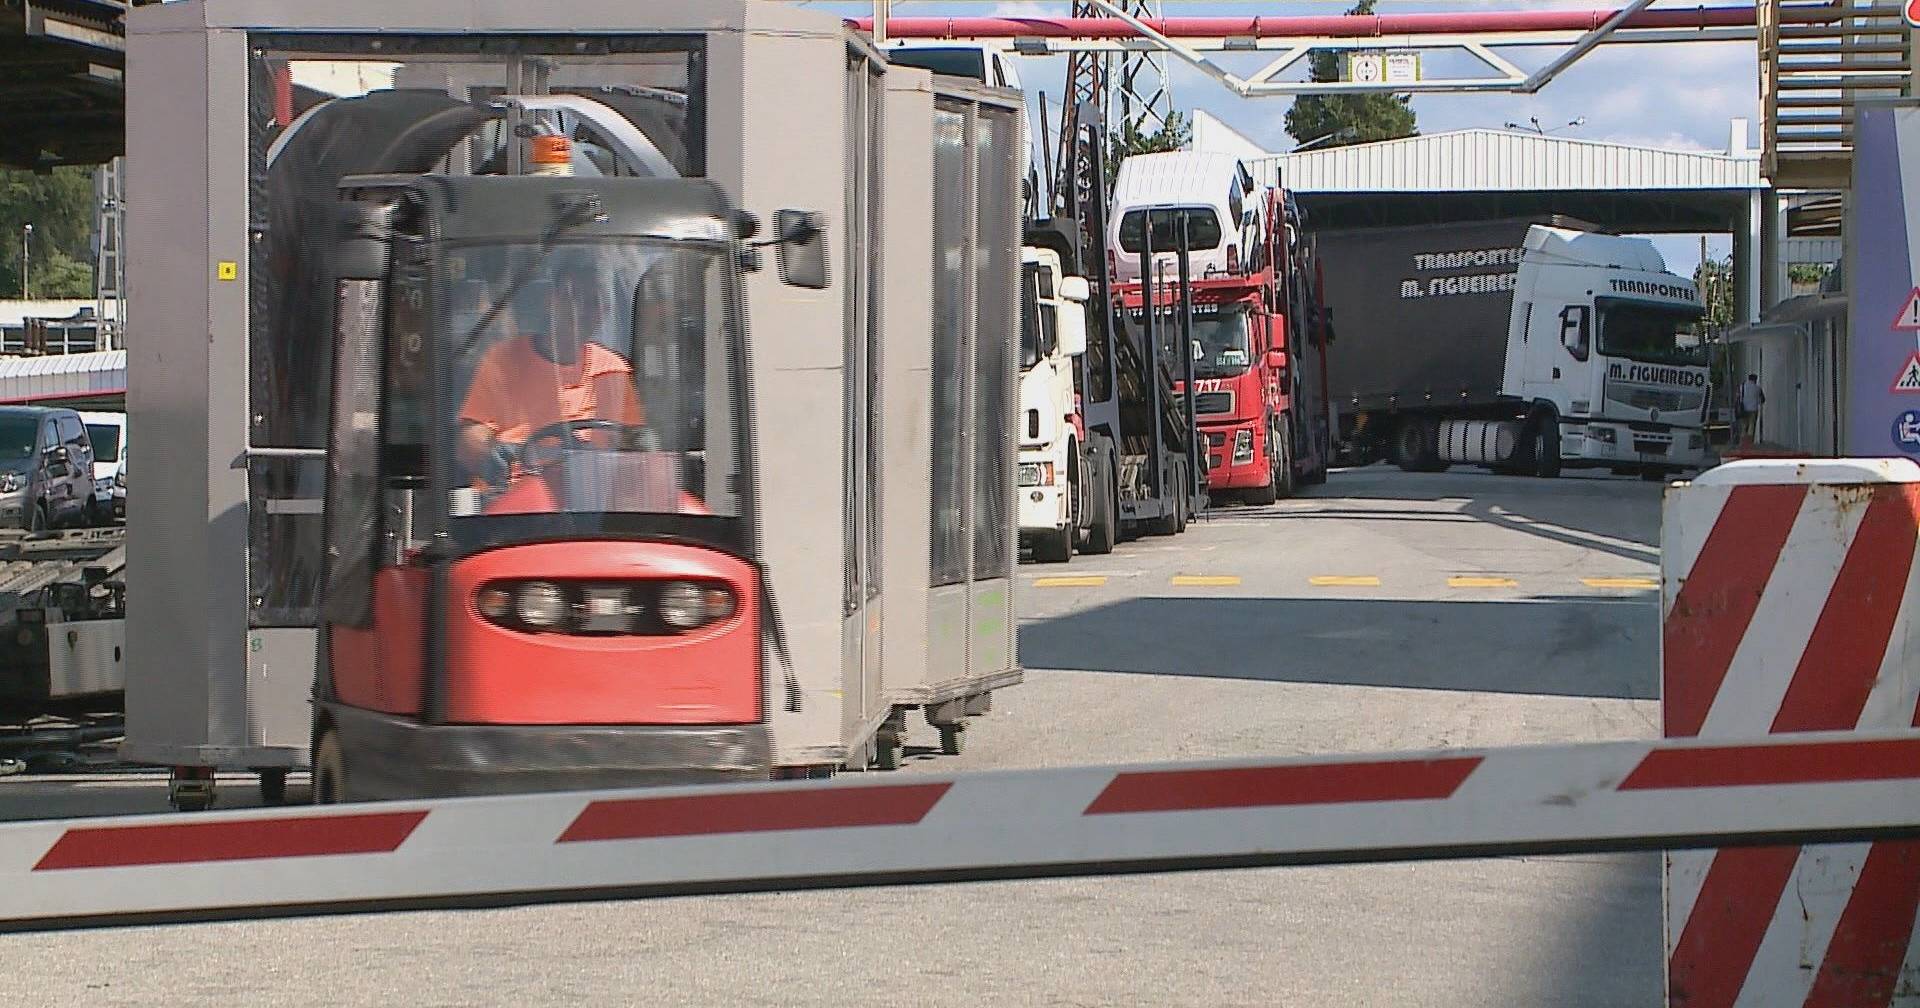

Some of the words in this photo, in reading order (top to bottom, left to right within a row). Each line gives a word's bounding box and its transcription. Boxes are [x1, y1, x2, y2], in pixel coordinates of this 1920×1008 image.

[1401, 280, 1424, 298] M.
[1429, 272, 1517, 296] FIGUEIRED
[1609, 279, 1694, 301] TRANSPORTES
[1609, 363, 1626, 379] M.
[1629, 365, 1705, 387] FIGUEIREDO
